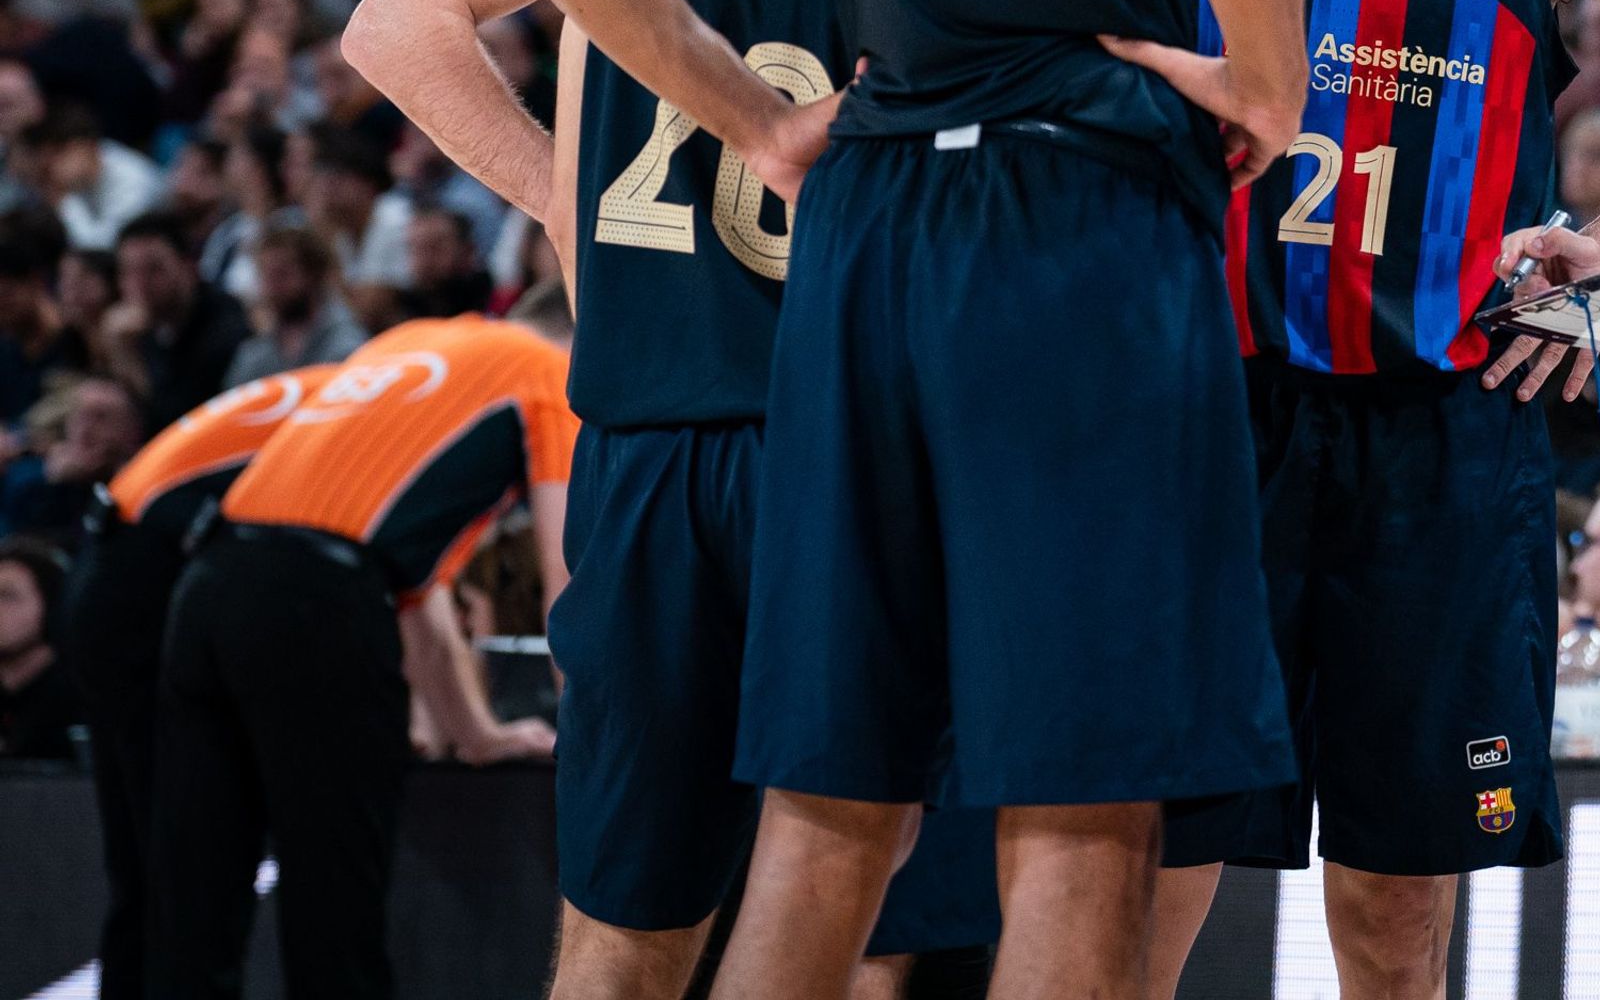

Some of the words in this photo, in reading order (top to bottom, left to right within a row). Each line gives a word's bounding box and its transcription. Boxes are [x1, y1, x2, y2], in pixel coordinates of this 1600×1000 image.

[1314, 32, 1486, 86] Assistència
[1311, 63, 1434, 108] Sanitària
[1277, 132, 1398, 256] 21
[1472, 749, 1502, 765] acb
